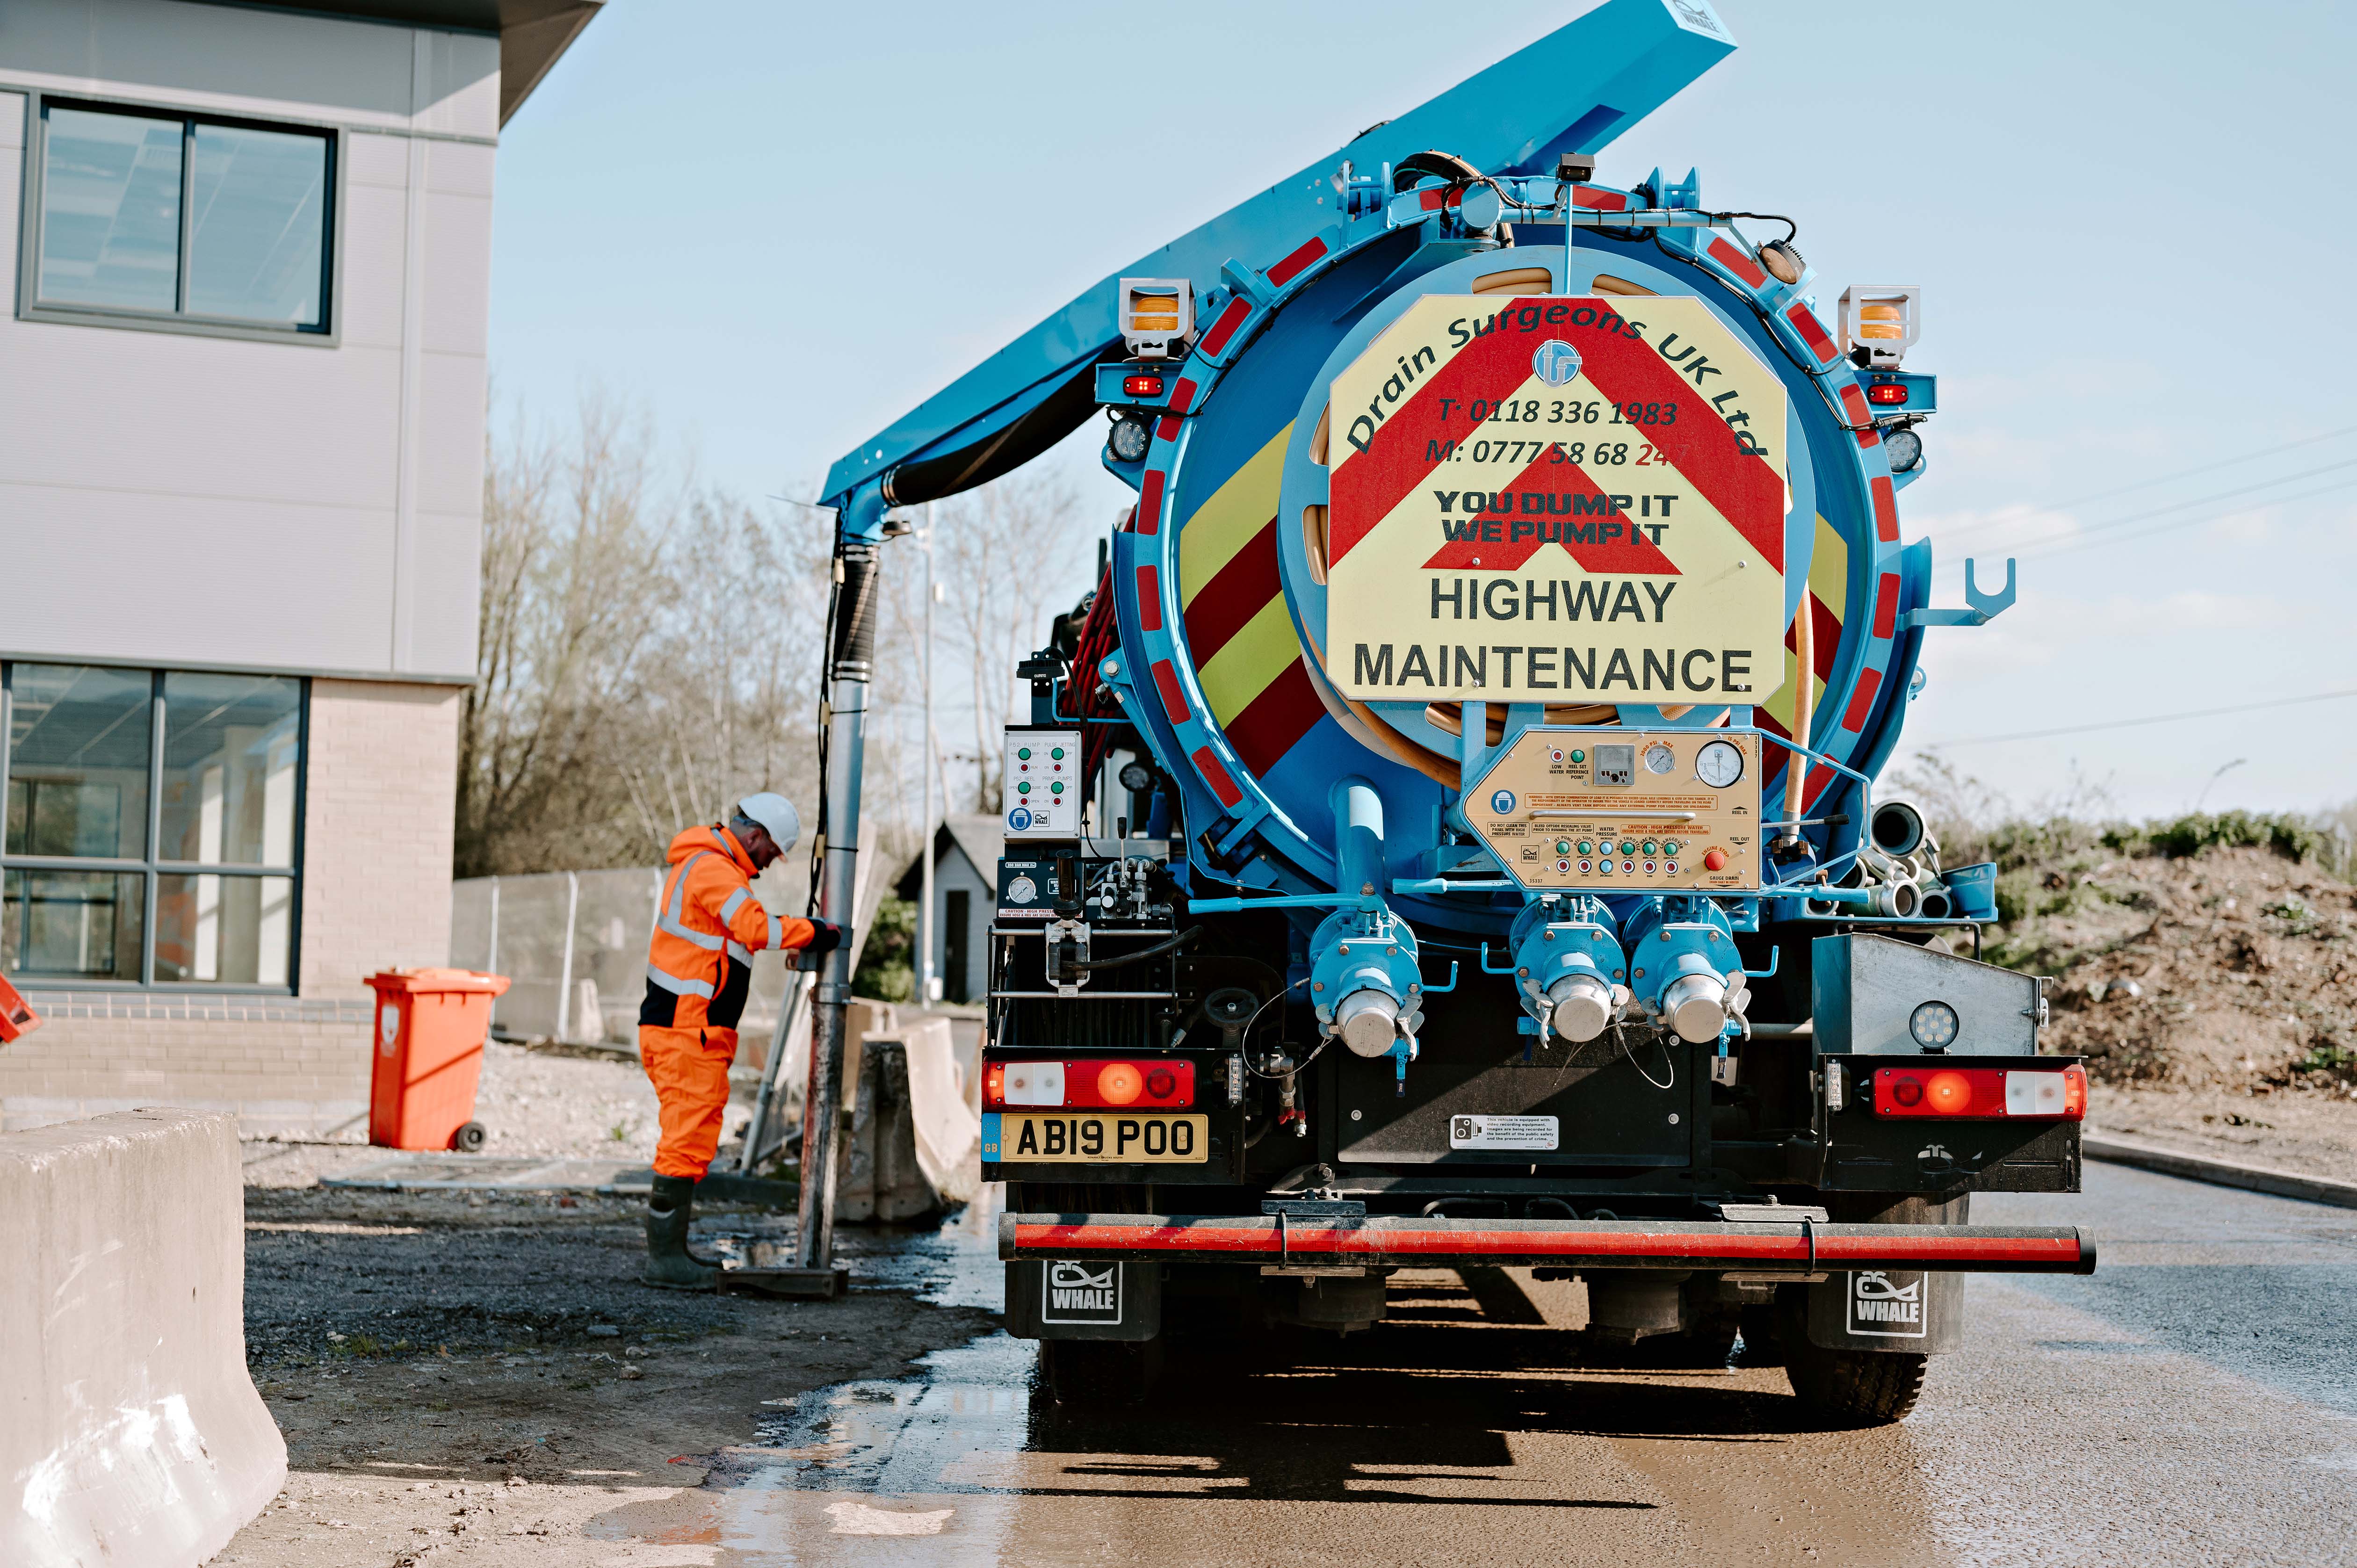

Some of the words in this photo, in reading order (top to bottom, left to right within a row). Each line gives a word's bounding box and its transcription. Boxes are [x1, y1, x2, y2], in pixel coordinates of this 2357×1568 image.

[1347, 346, 1437, 455] Drain
[1448, 303, 1647, 349] Surgeons
[1659, 332, 1722, 386] UK
[1711, 390, 1769, 456] Ltd
[1470, 399, 1540, 423] 0118
[1547, 401, 1600, 424] 336
[1609, 402, 1678, 425] 1983
[1425, 440, 1463, 462] M:
[1473, 441, 1543, 463] 0777
[1550, 442, 1585, 465] 58
[1594, 443, 1628, 465] 68
[1433, 491, 1512, 514] YOU
[1522, 493, 1633, 516] DUMP
[1641, 495, 1678, 517] IT
[1442, 519, 1502, 542] WE
[1511, 520, 1623, 544] PUMP
[1631, 523, 1669, 546] IT
[1431, 578, 1677, 622] HIGHWAY
[1354, 643, 1752, 693] MAINTENANCE
[1663, 741, 1674, 749] MAX
[1739, 745, 1748, 755] MAX
[1582, 836, 1597, 846] SUPPLY
[1623, 836, 1640, 851] THROTTLE
[1648, 837, 1660, 845] PUMP
[1660, 837, 1684, 849] CHANGEOVER
[1701, 845, 1718, 856] ENGINE
[1719, 847, 1729, 858] STOP
[1017, 1120, 1104, 1155] AB19
[984, 1143, 998, 1153] GB
[1052, 1289, 1114, 1309] WHALE
[1857, 1301, 1919, 1322] WHALE
